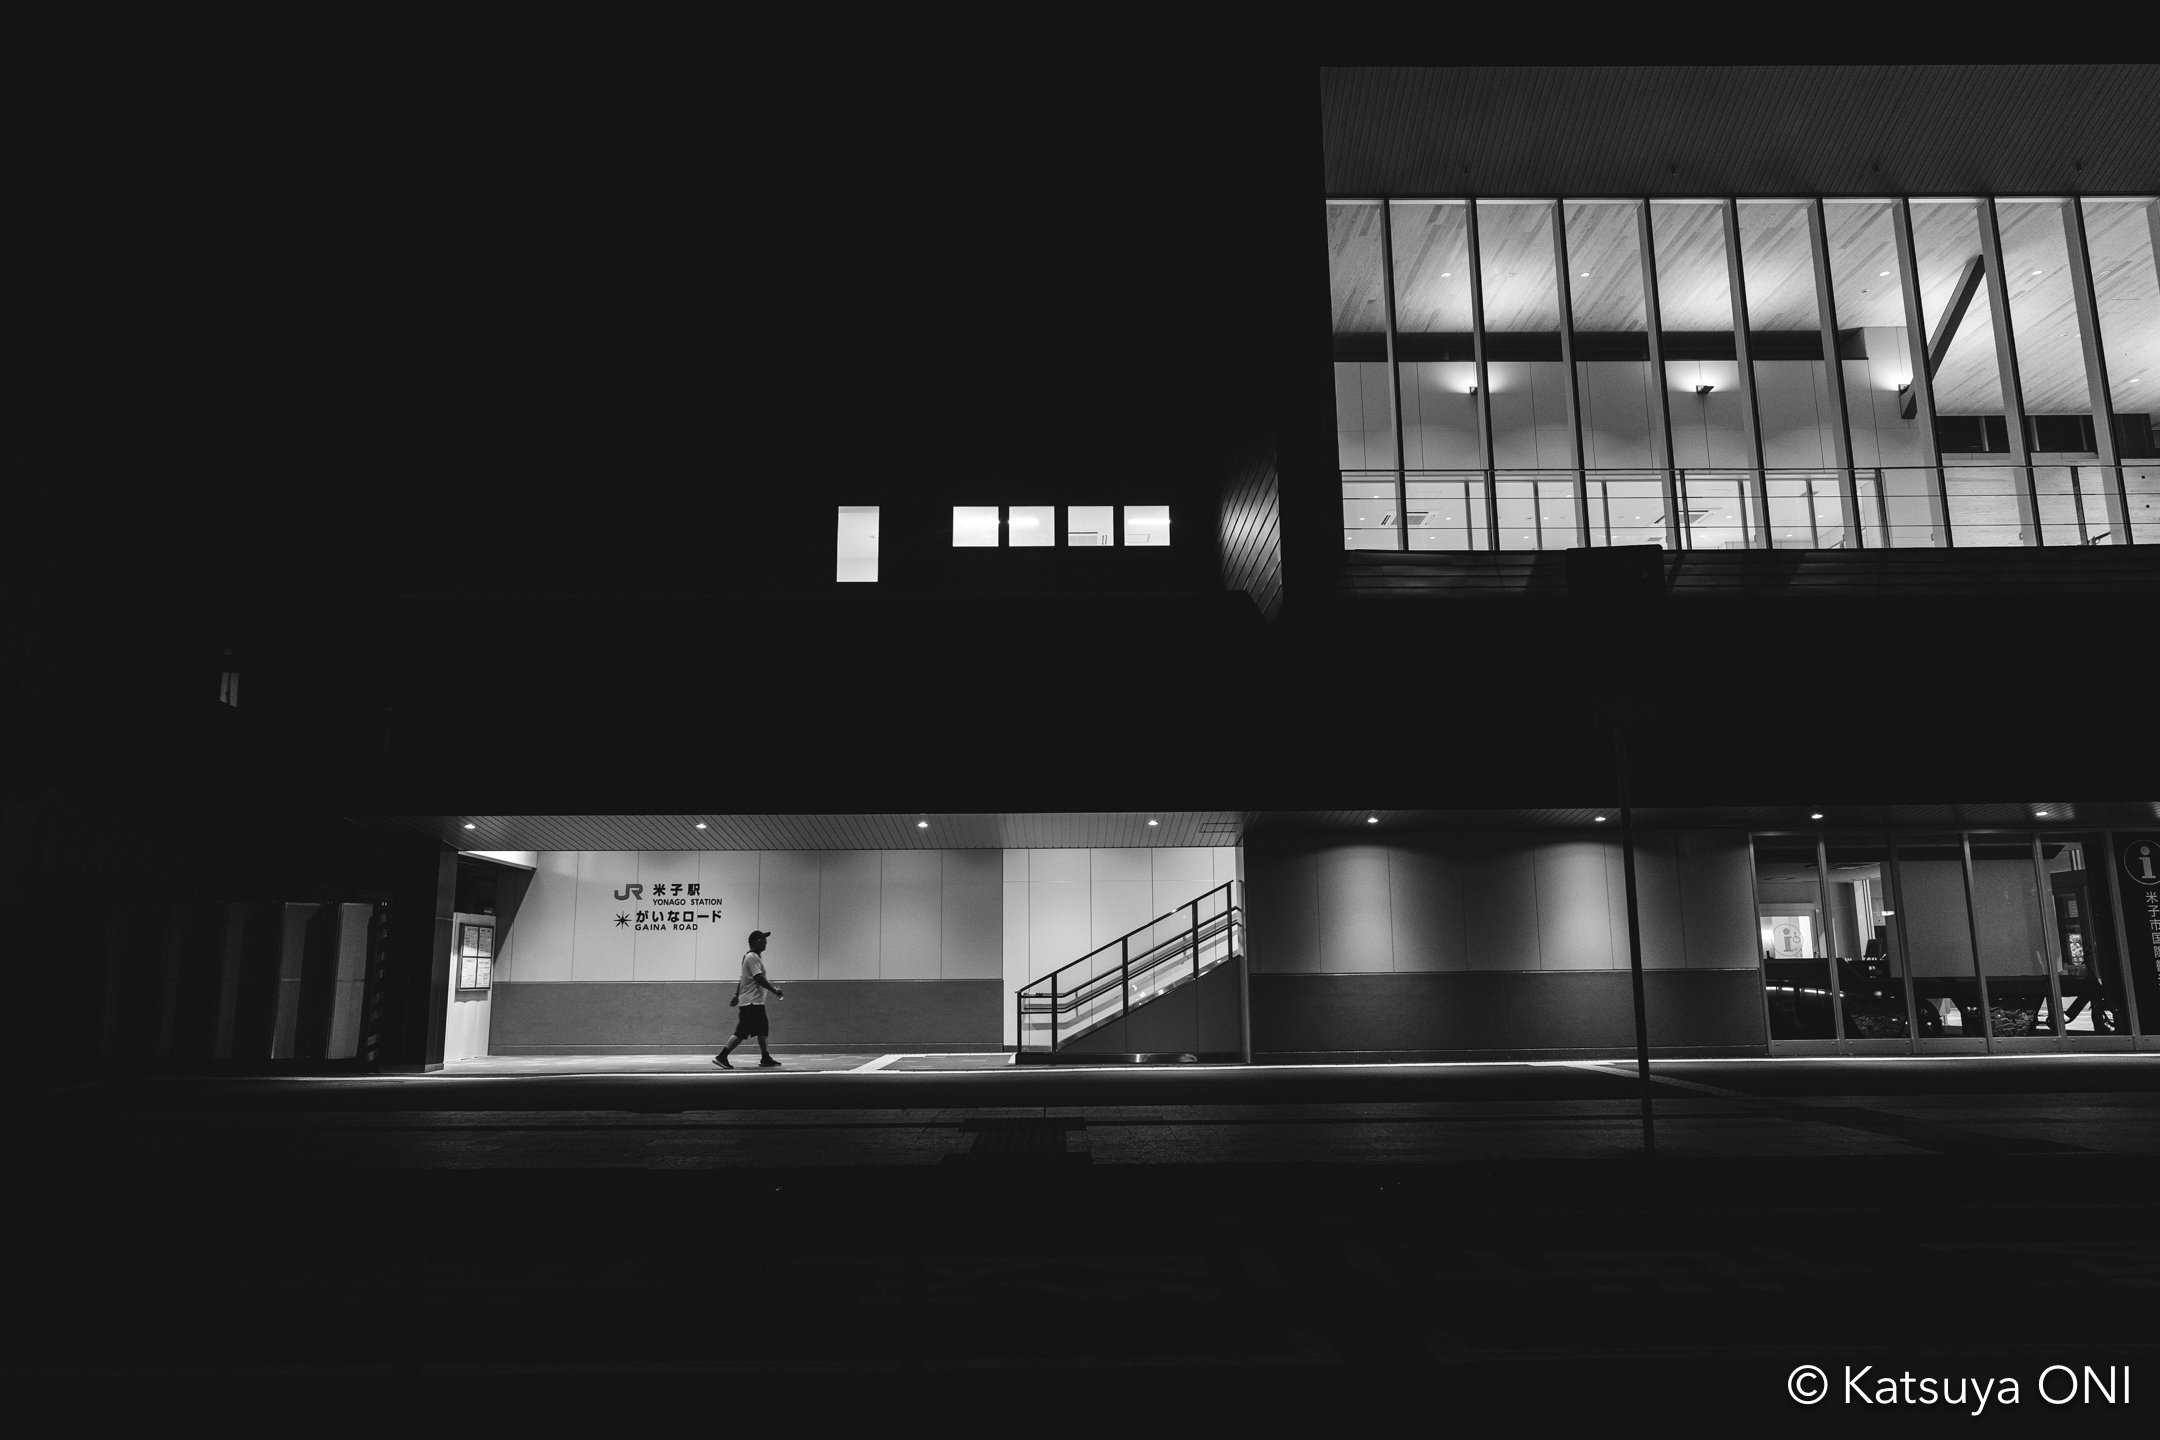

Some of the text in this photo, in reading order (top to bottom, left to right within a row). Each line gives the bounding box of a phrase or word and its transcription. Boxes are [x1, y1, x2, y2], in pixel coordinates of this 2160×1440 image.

[614, 883, 643, 900] JR
[653, 883, 701, 896] 米子駅
[652, 898, 723, 906] YONAGO STATION
[636, 910, 722, 923] がいなロード
[635, 923, 698, 931] GAINA ROAD
